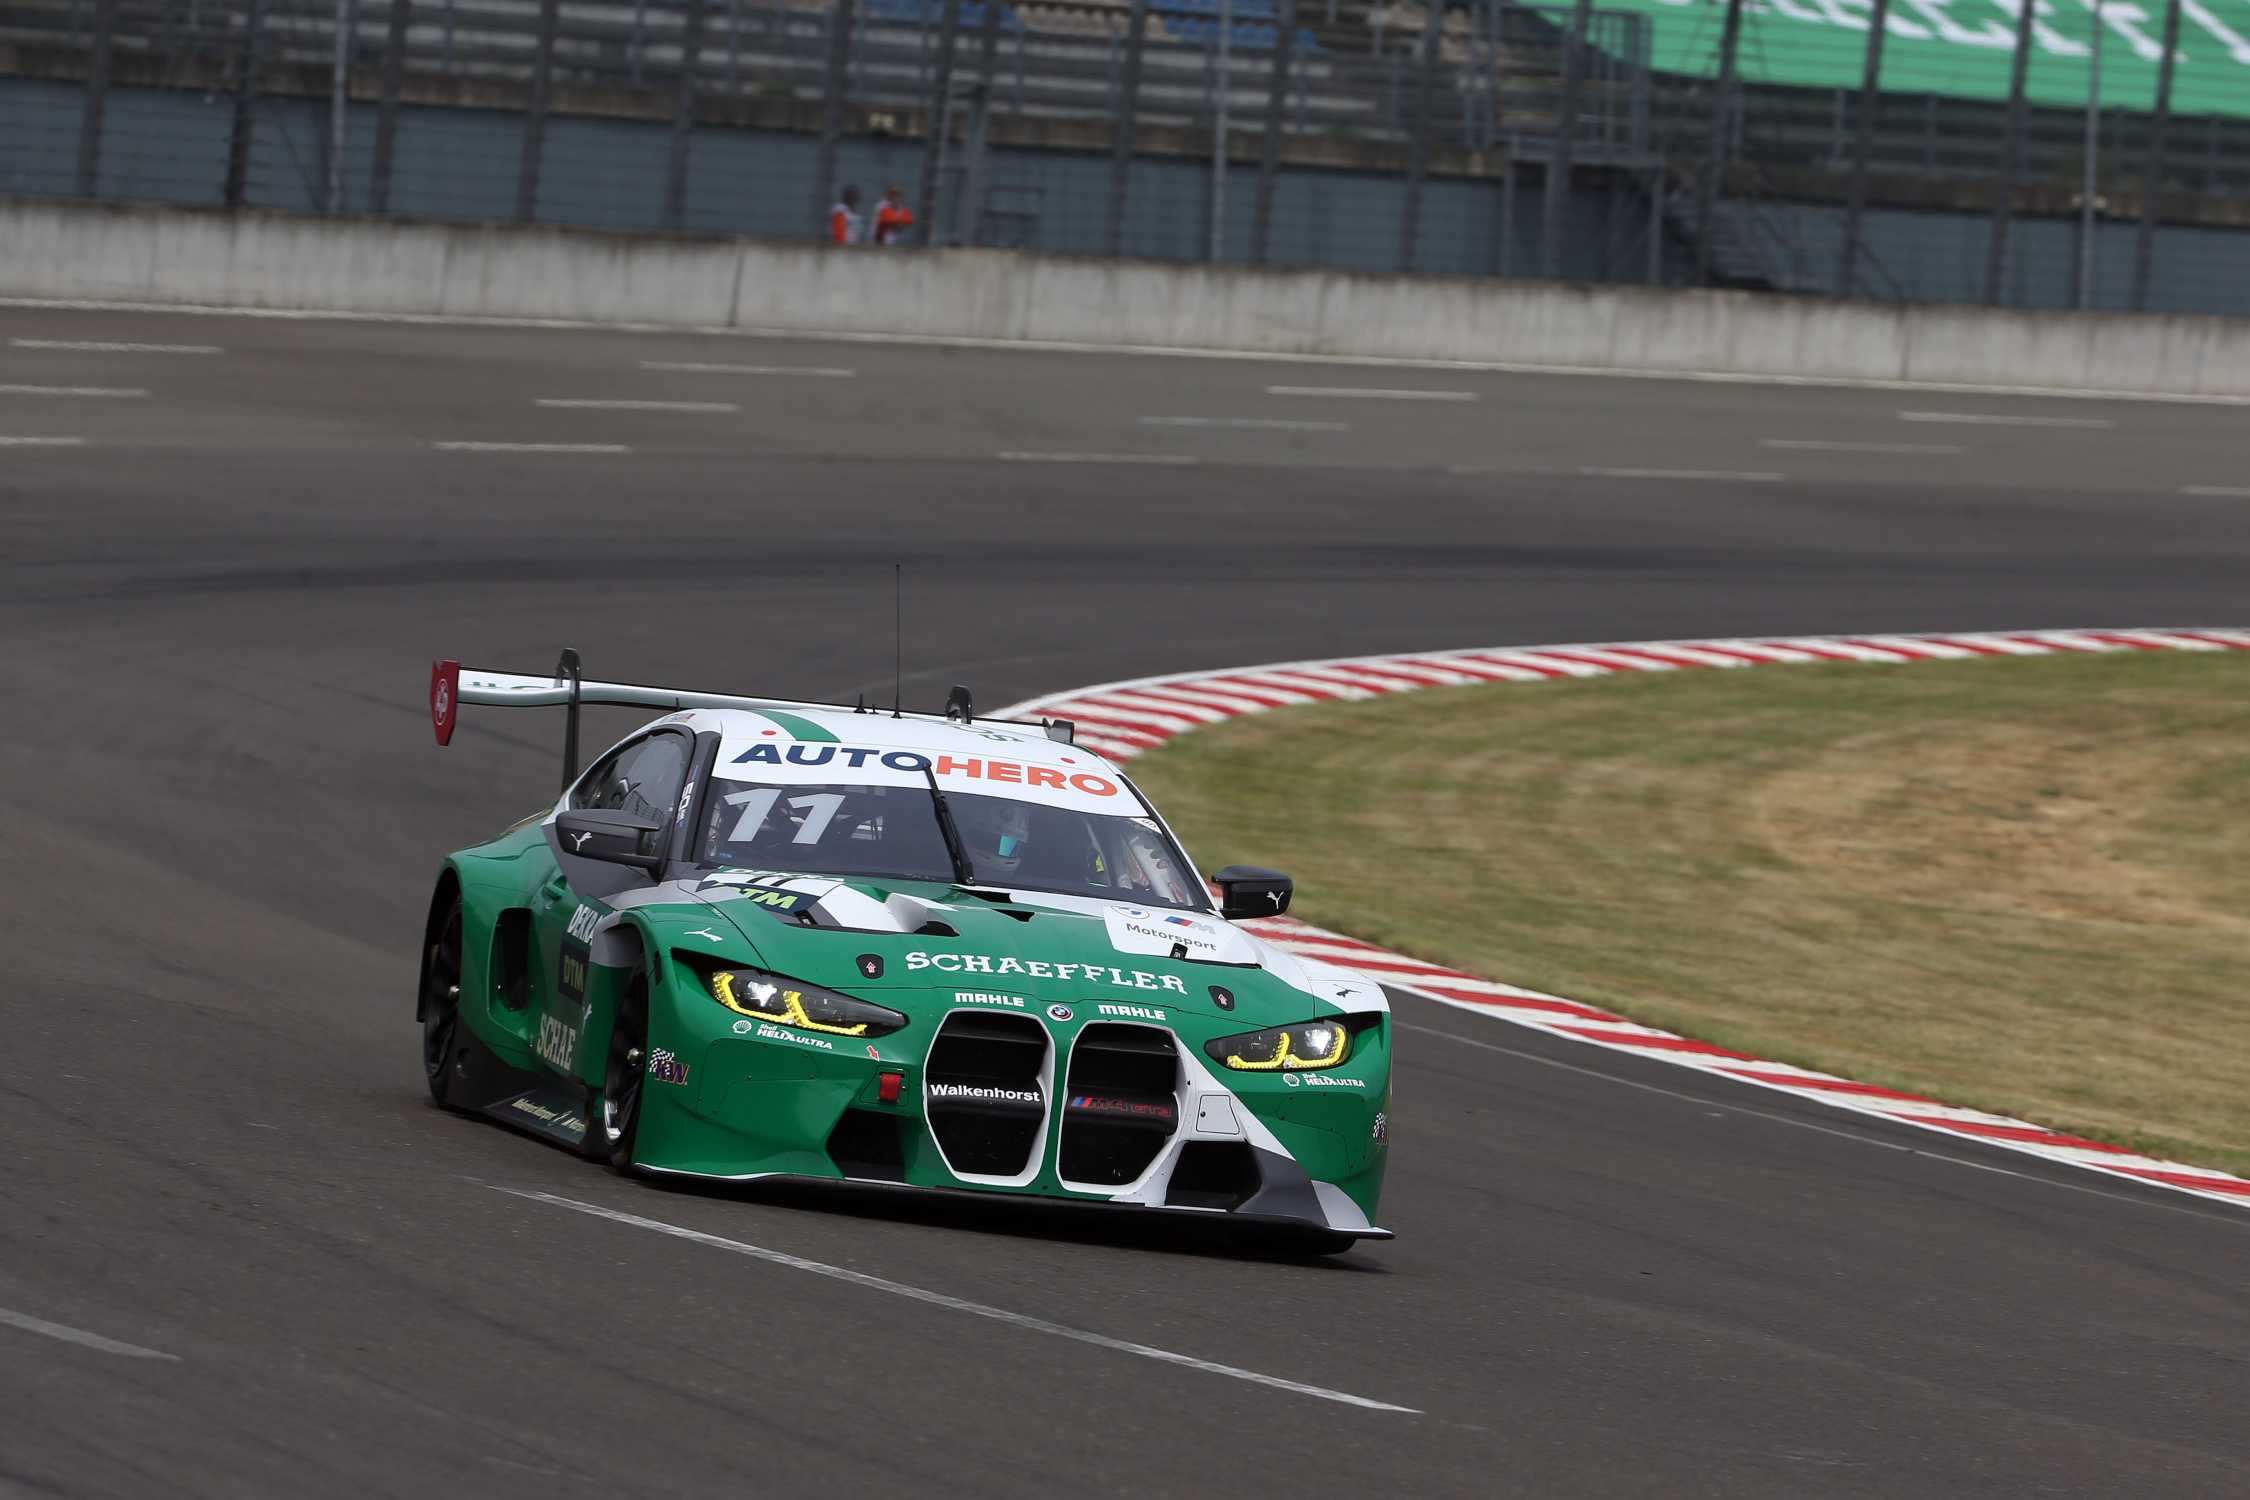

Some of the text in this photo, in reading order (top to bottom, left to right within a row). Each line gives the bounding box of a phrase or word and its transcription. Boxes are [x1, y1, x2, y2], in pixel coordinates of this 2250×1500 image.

[730, 743, 1118, 797] AUTOHERO
[722, 788, 846, 845] 11
[1126, 923, 1217, 951] Motorsport
[562, 955, 584, 993] DTM
[905, 951, 1188, 995] SCHAEFFLER
[955, 991, 1025, 1008] MAHLE
[1097, 1003, 1167, 1021] MAHLE
[759, 1023, 778, 1031] Shell
[756, 1028, 833, 1050] HELIX ULTRA
[930, 1083, 1041, 1102] Walkenhorst
[1335, 1078, 1366, 1088] ULTRA
